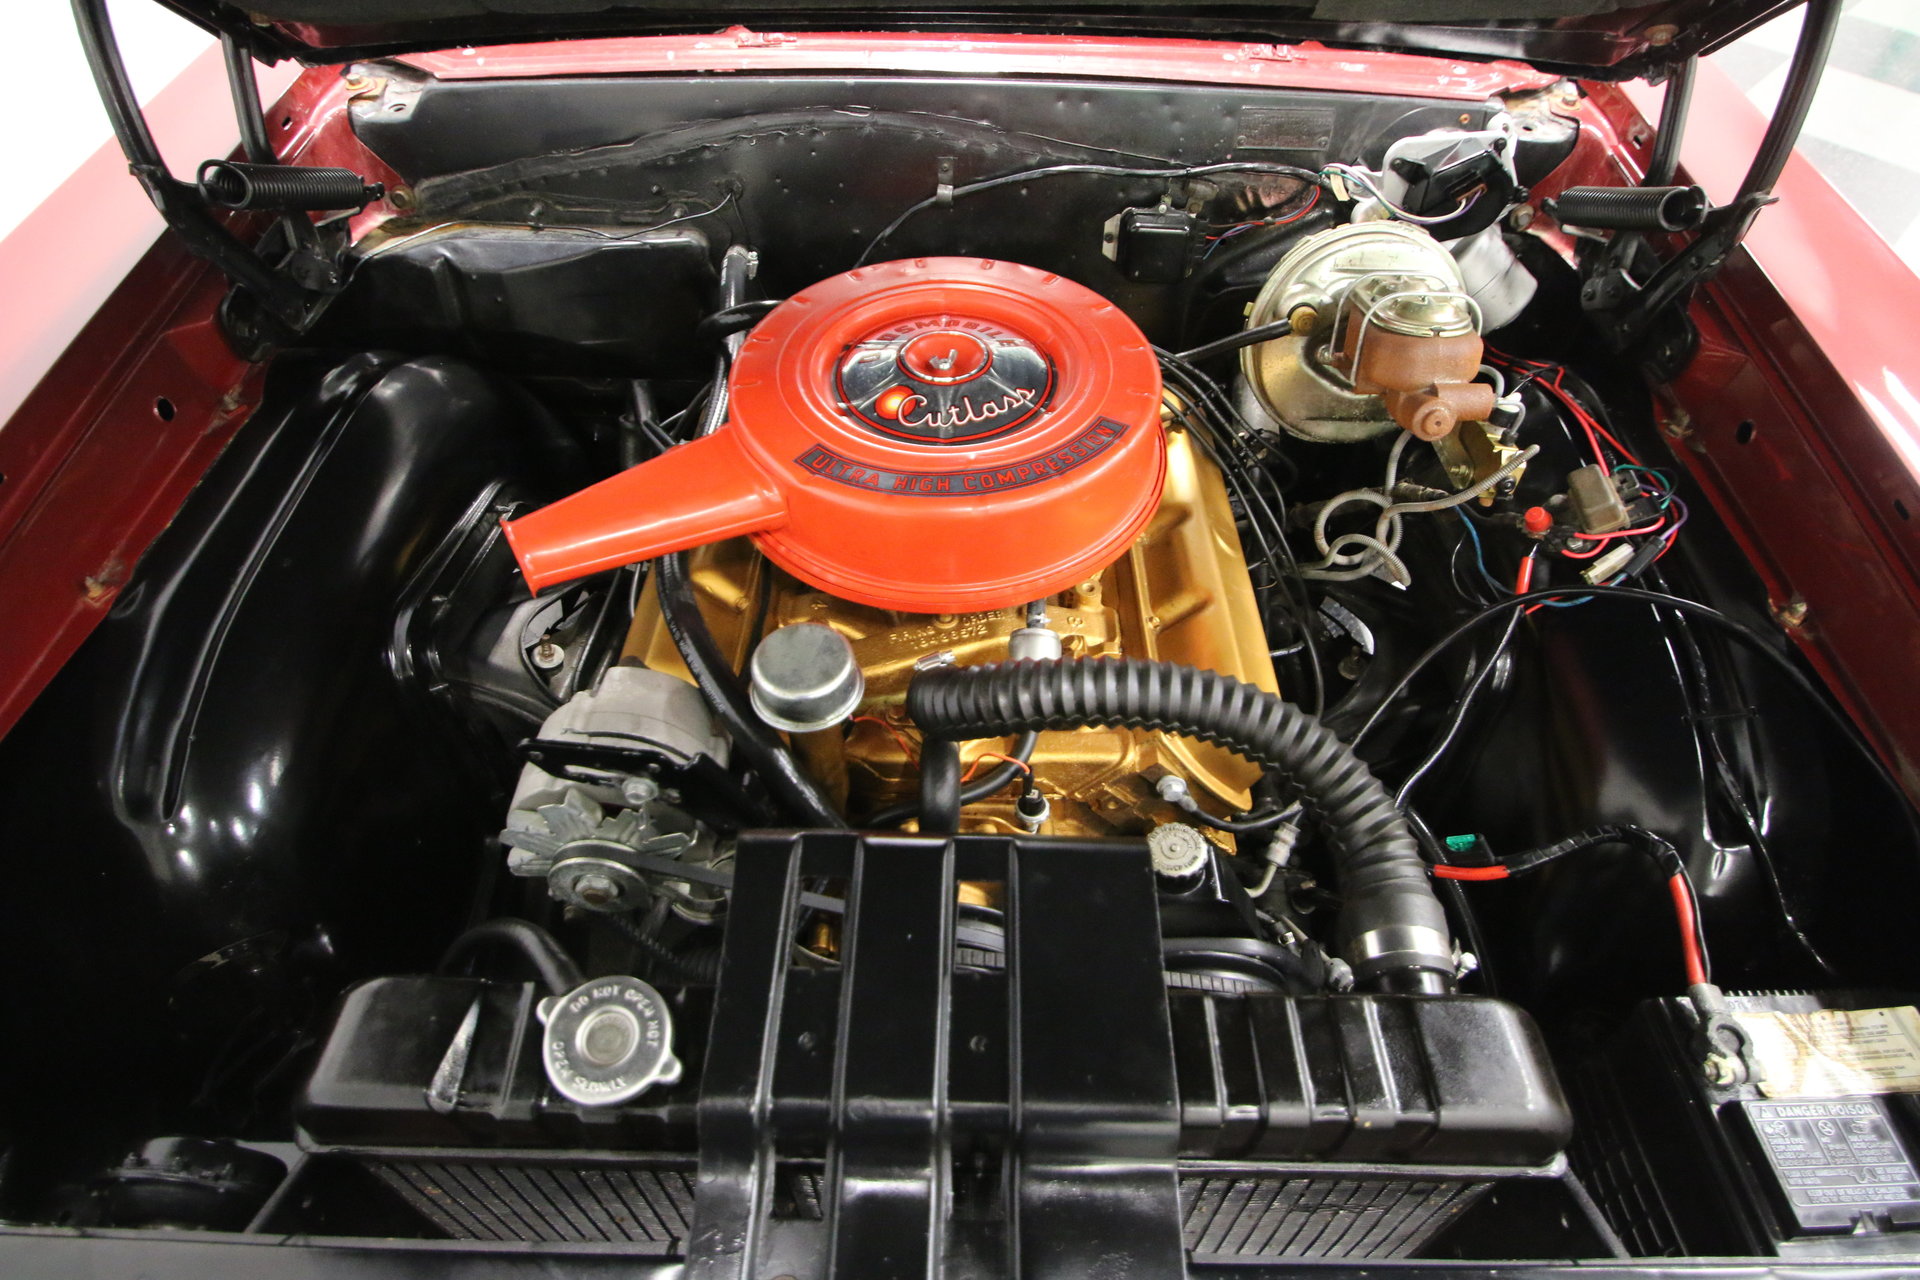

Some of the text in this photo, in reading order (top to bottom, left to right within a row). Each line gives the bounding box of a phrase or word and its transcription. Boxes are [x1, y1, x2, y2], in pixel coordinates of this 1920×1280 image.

[897, 387, 1035, 427] Cutlass
[814, 425, 1113, 492] ULTRA HIGH COMPRESSION
[569, 984, 661, 1047] DO NOT OPEN HOT
[551, 1040, 574, 1079] OPEN
